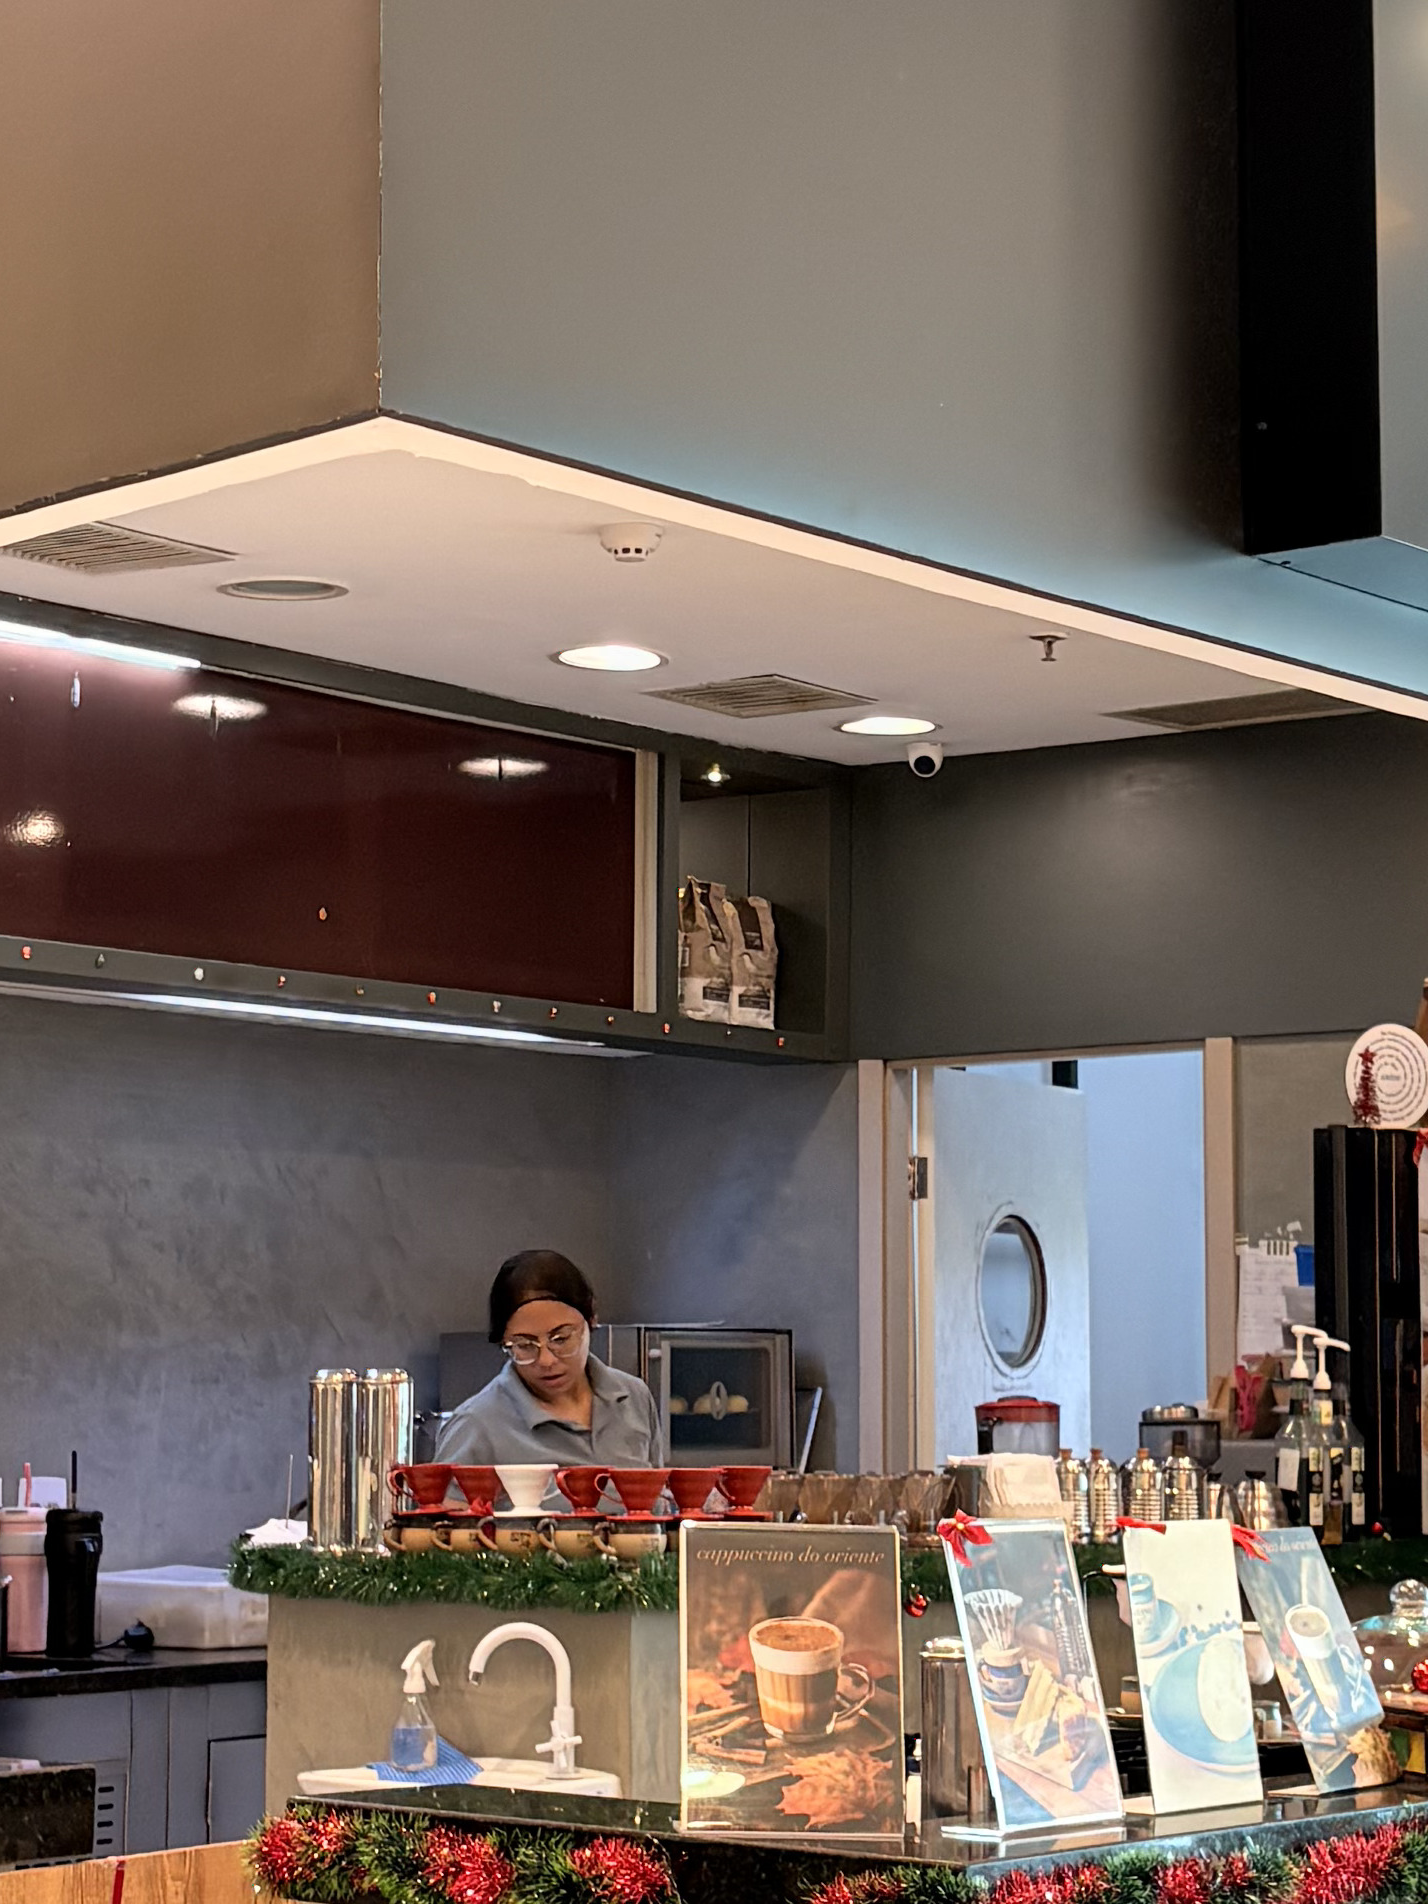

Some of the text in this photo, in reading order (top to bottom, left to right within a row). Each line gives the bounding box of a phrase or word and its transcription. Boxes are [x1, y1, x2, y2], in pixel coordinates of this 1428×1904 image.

[696, 1544, 885, 1566] cappuccino do oriente
